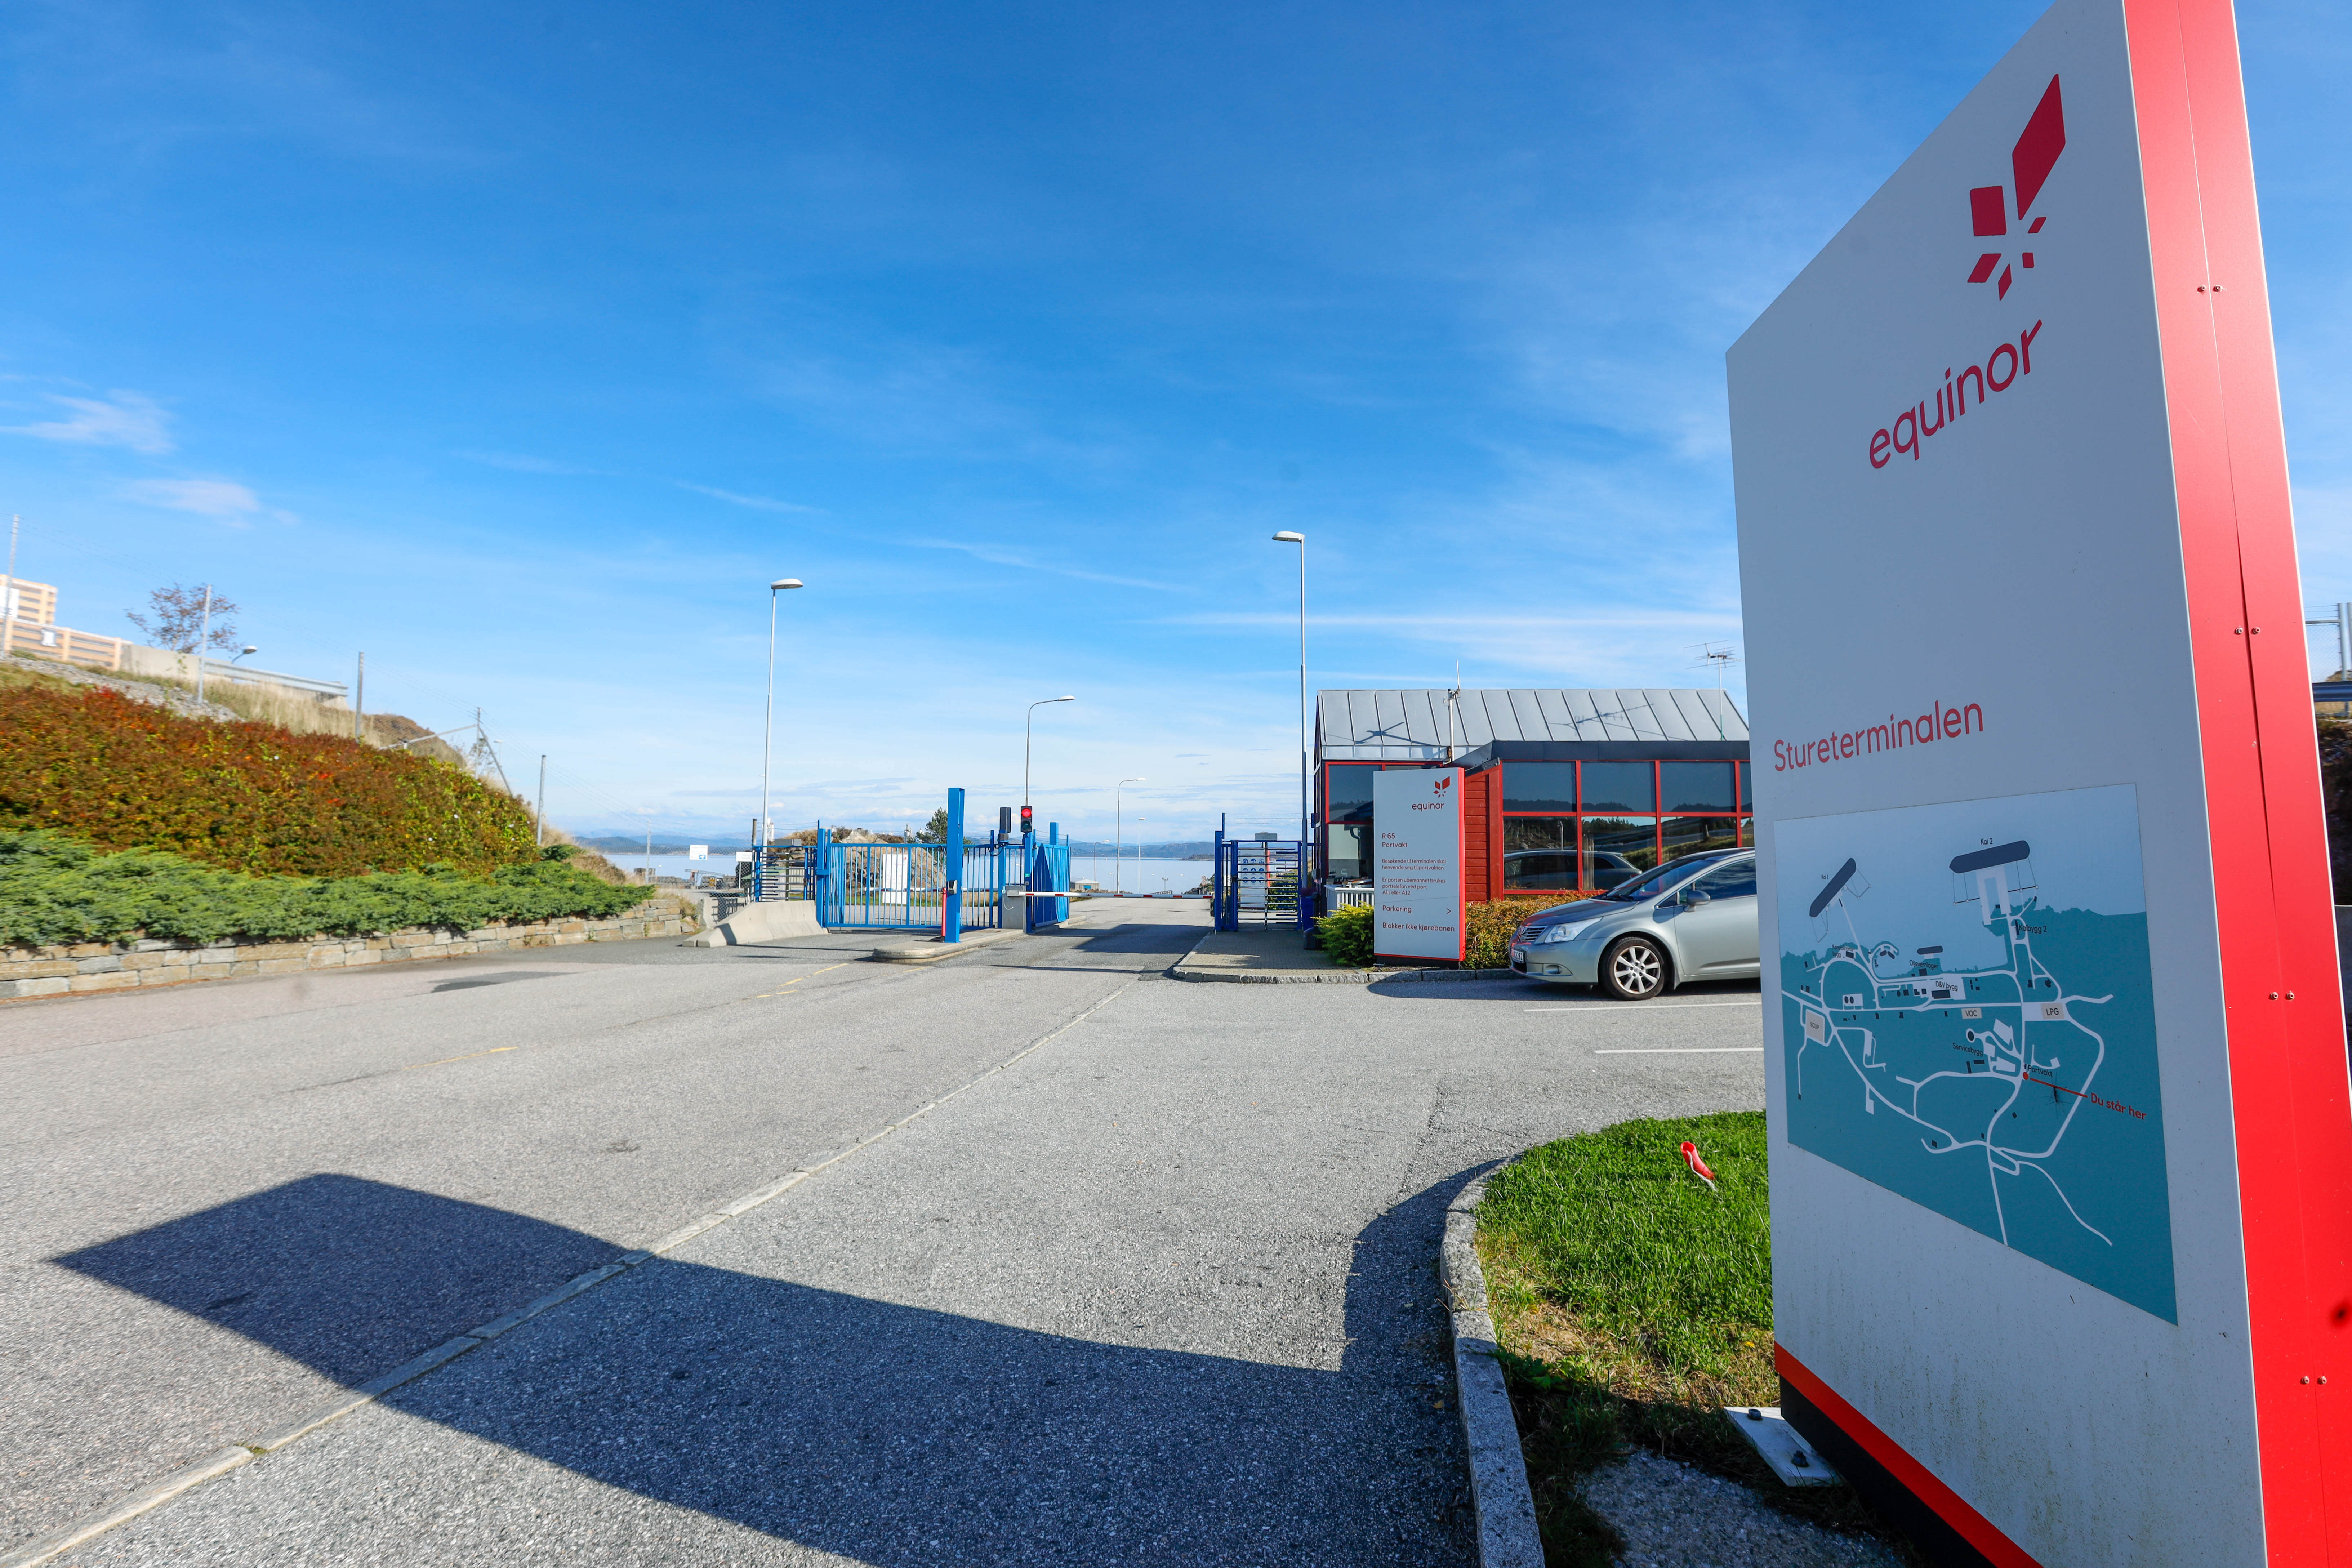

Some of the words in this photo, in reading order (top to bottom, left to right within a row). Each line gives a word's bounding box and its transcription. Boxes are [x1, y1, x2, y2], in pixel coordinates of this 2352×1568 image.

[1869, 318, 2042, 469] equinor
[1774, 700, 1983, 772] Stureterminalen
[1412, 802, 1444, 812] equinor
[1382, 905, 1412, 913] Parkering
[2019, 924, 2041, 934] Kaibygg
[1910, 960, 1938, 970] Oljevernlager
[1946, 983, 1958, 991] bygg
[1953, 1043, 1983, 1056] Servicebygg
[2028, 1064, 2053, 1077] Portvakt
[2091, 1092, 2103, 1106] Du
[2106, 1101, 2126, 1113] står
[2129, 1105, 2146, 1119] her
